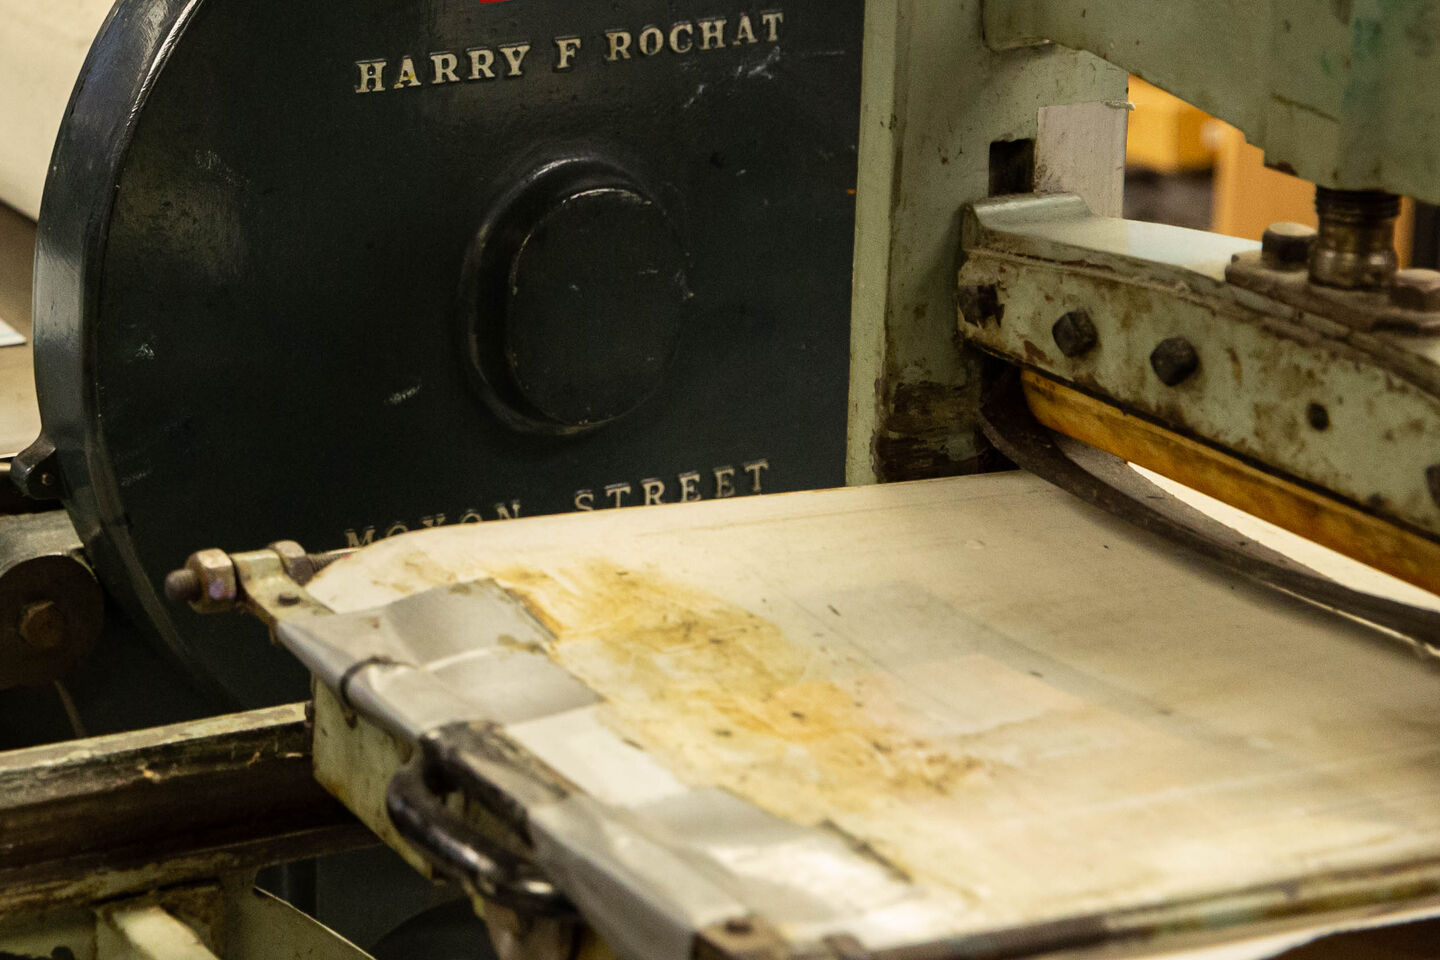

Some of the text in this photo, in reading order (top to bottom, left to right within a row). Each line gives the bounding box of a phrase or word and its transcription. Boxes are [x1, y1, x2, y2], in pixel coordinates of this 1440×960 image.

[355, 12, 785, 93] HARRY F ROCHAT
[574, 458, 770, 511] STREET
